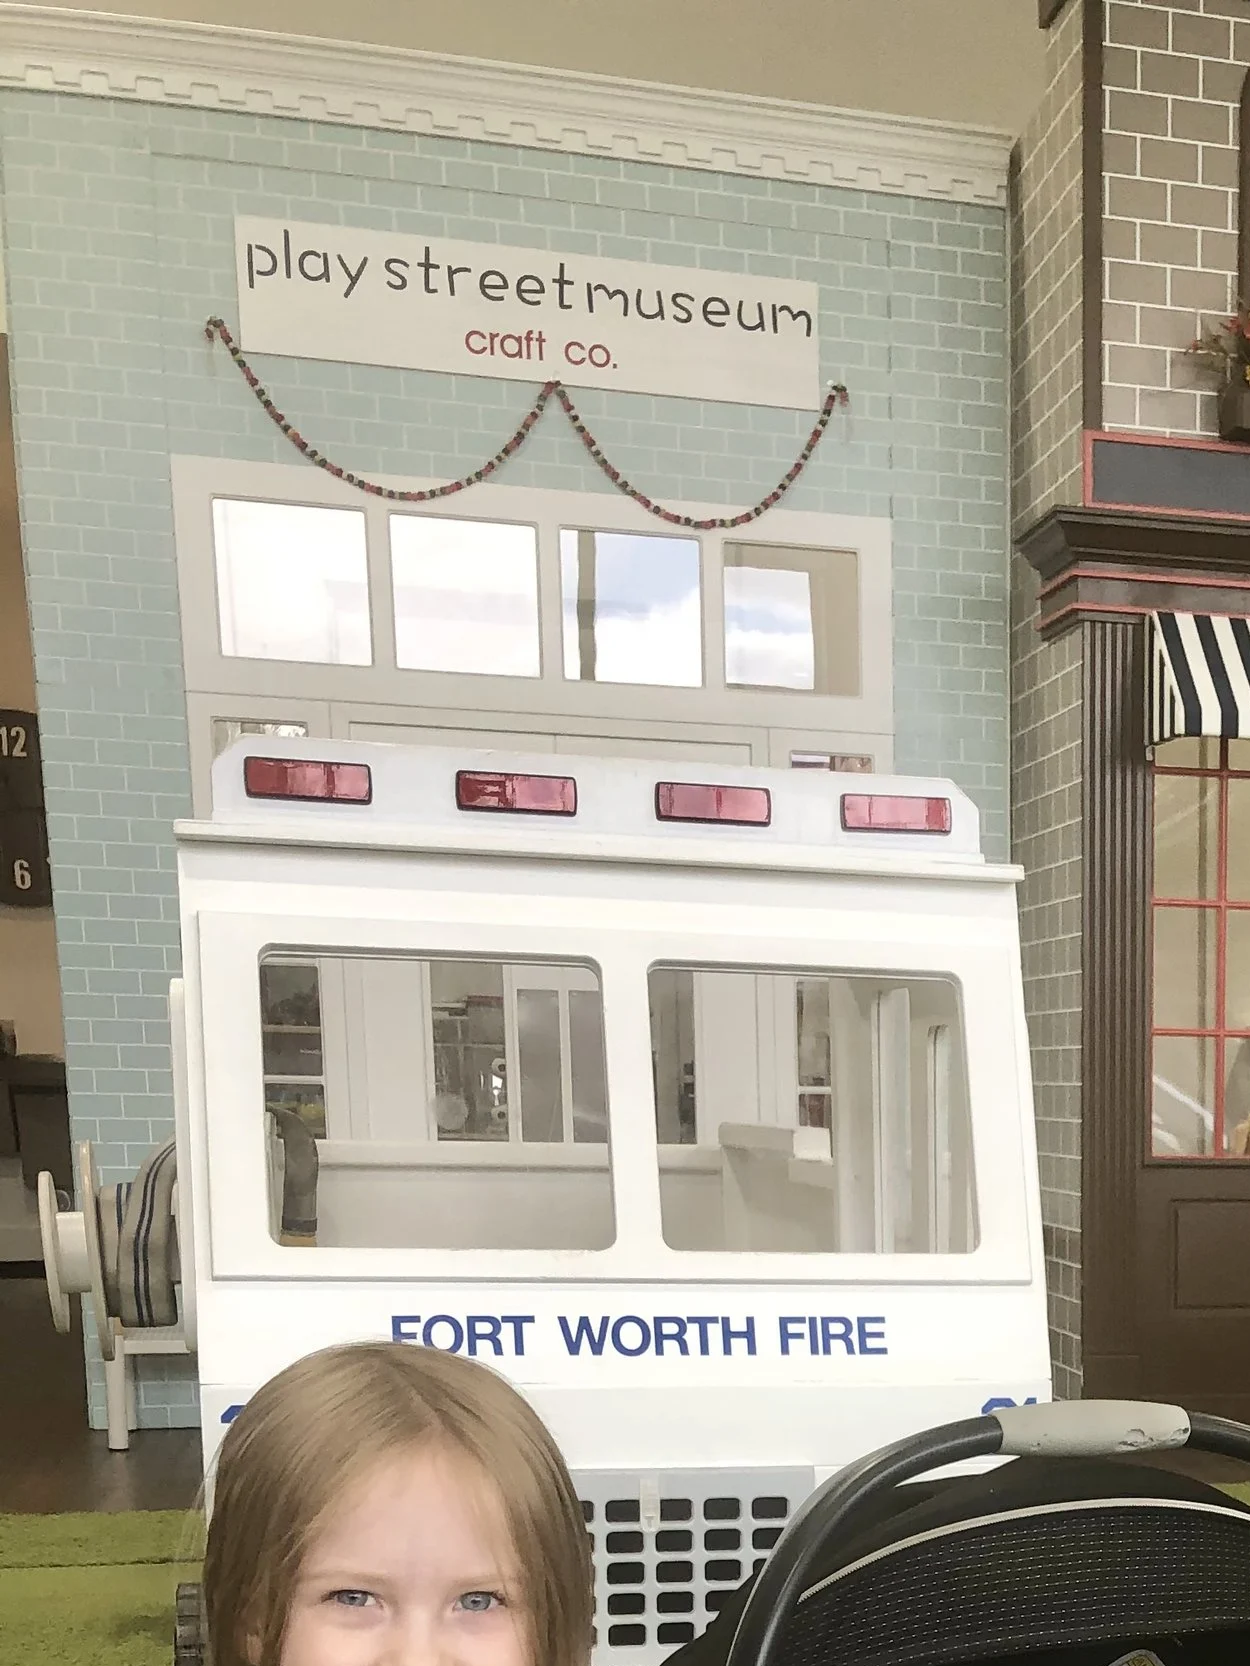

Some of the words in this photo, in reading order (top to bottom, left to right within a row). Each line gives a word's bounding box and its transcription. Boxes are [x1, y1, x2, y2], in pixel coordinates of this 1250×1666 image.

[465, 329, 546, 361] craft
[564, 341, 617, 369] co.
[13, 859, 32, 890] 6
[391, 1315, 535, 1357] FORT
[557, 1315, 757, 1357] WORTH
[778, 1315, 888, 1356] FIRE
